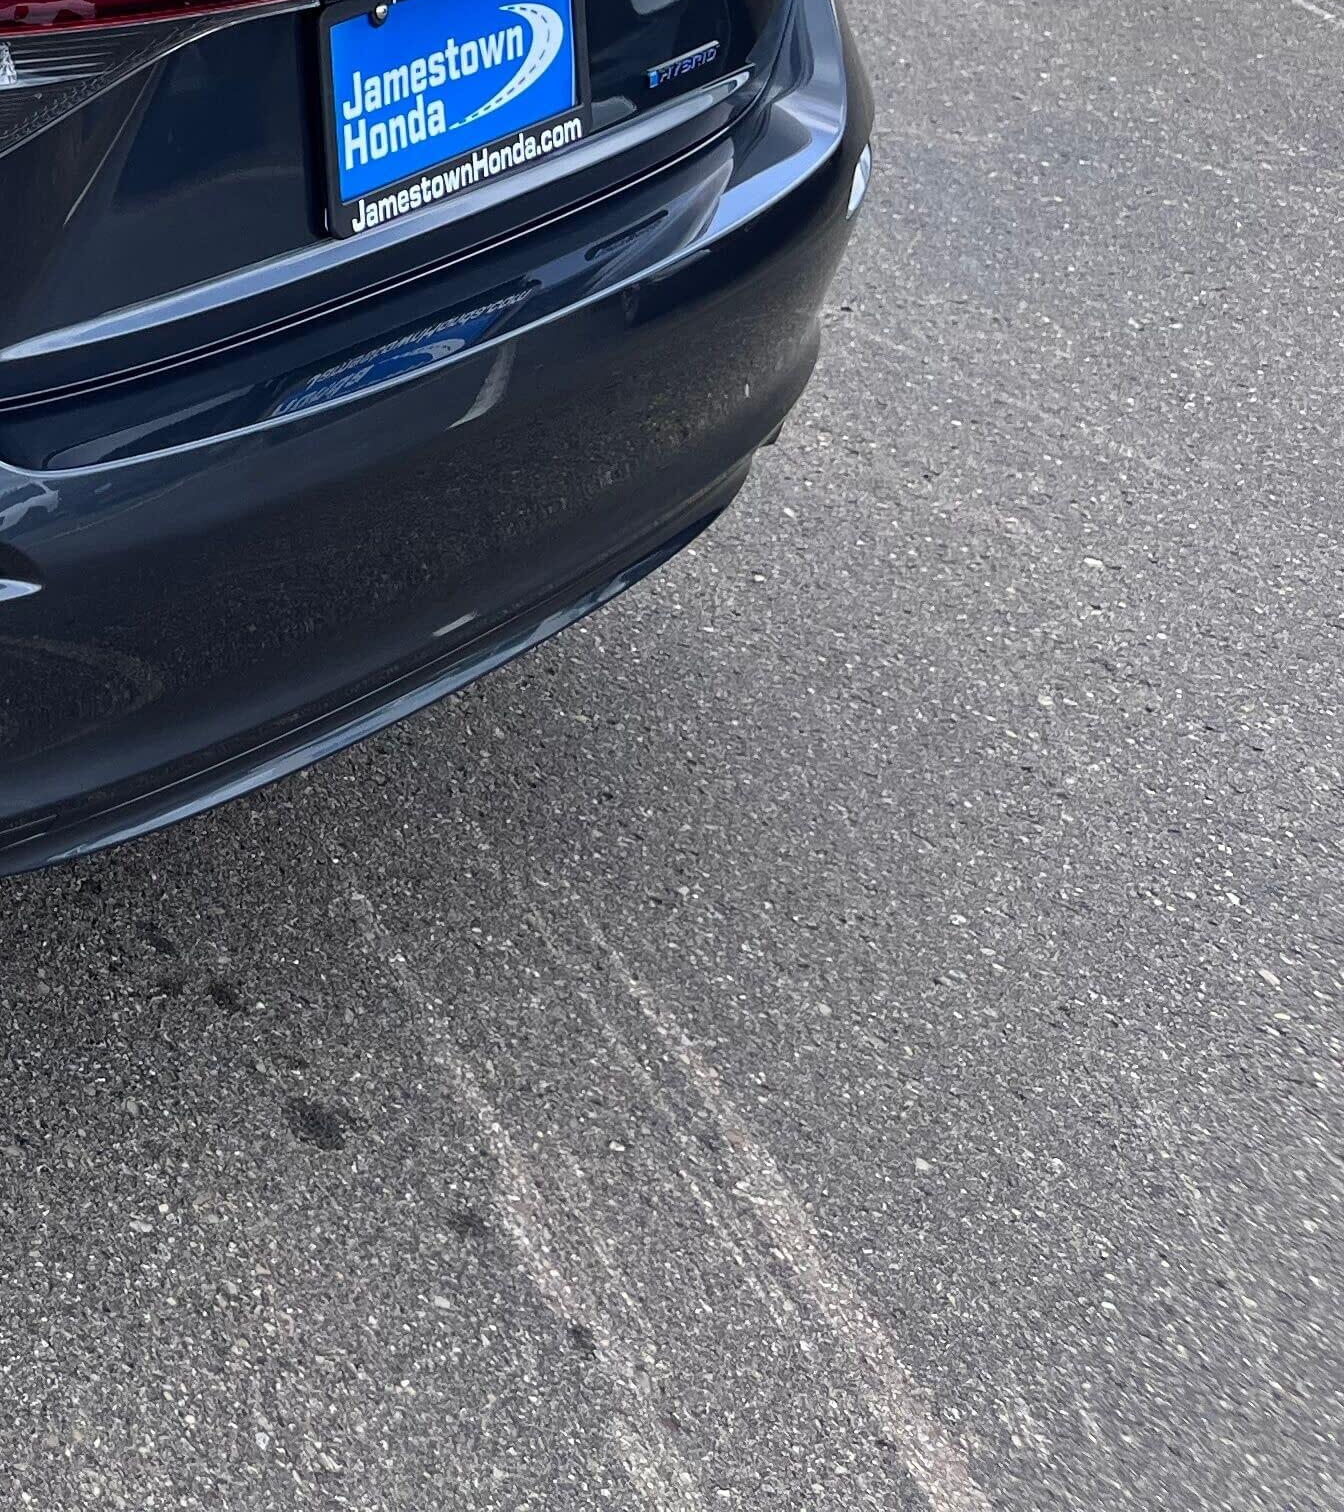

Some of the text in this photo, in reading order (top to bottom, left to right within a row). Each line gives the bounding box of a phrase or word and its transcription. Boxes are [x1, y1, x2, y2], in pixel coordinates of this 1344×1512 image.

[342, 24, 524, 120] Jamestown
[343, 94, 448, 171] Honda
[352, 117, 582, 233] JamestownHonda.com
